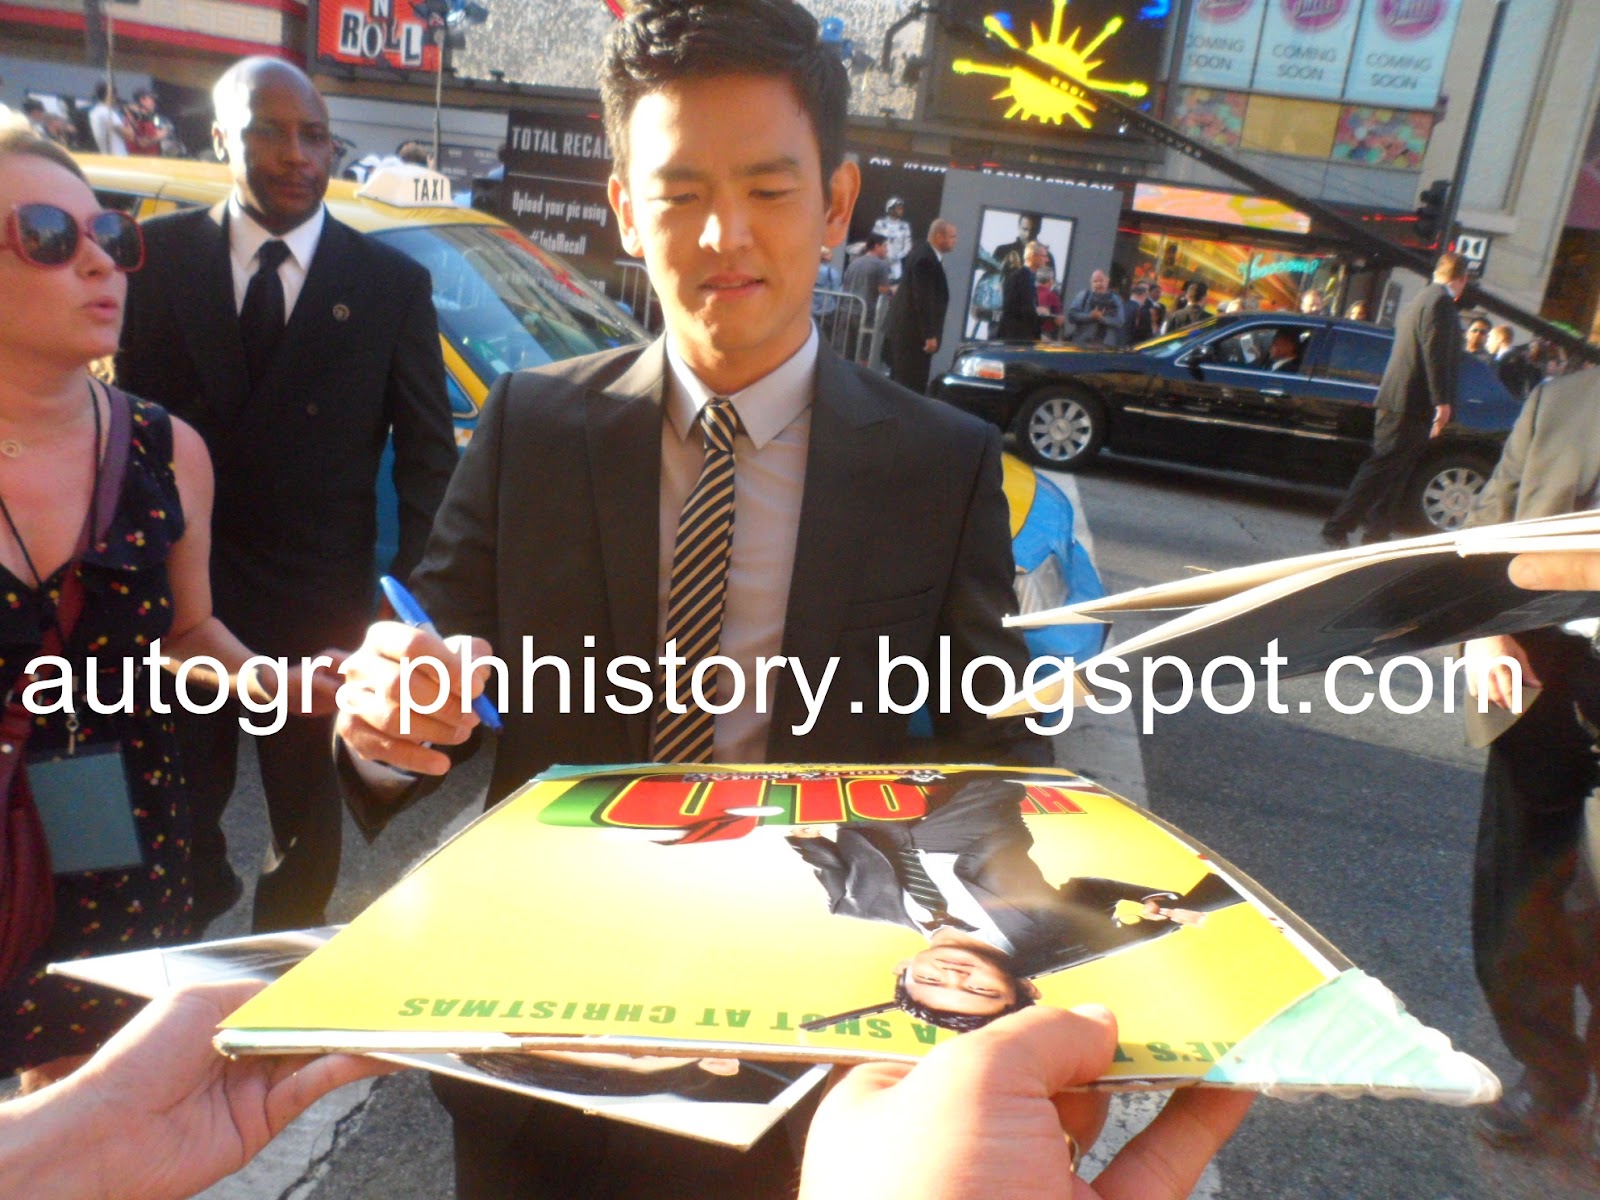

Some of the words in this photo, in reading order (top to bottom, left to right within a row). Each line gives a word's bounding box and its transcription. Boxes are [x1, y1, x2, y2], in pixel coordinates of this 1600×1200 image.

[340, 10, 421, 64] ROLL
[1271, 44, 1337, 63] COMING
[1365, 53, 1433, 72] COMING
[1277, 63, 1324, 79] SOON
[1371, 73, 1418, 90] SOON
[512, 126, 559, 154] TOTAL
[562, 132, 613, 160] RECAL
[413, 178, 444, 202] TAXI
[512, 190, 544, 216] Upload
[545, 200, 566, 221] your
[567, 200, 581, 222] pic
[582, 203, 608, 227] using
[529, 228, 587, 256] #TotalRecall
[600, 773, 1088, 829] HOLD
[397, 997, 677, 1025] CHRISTMAS
[695, 1007, 752, 1028] AT
[911, 1022, 937, 1045] A
